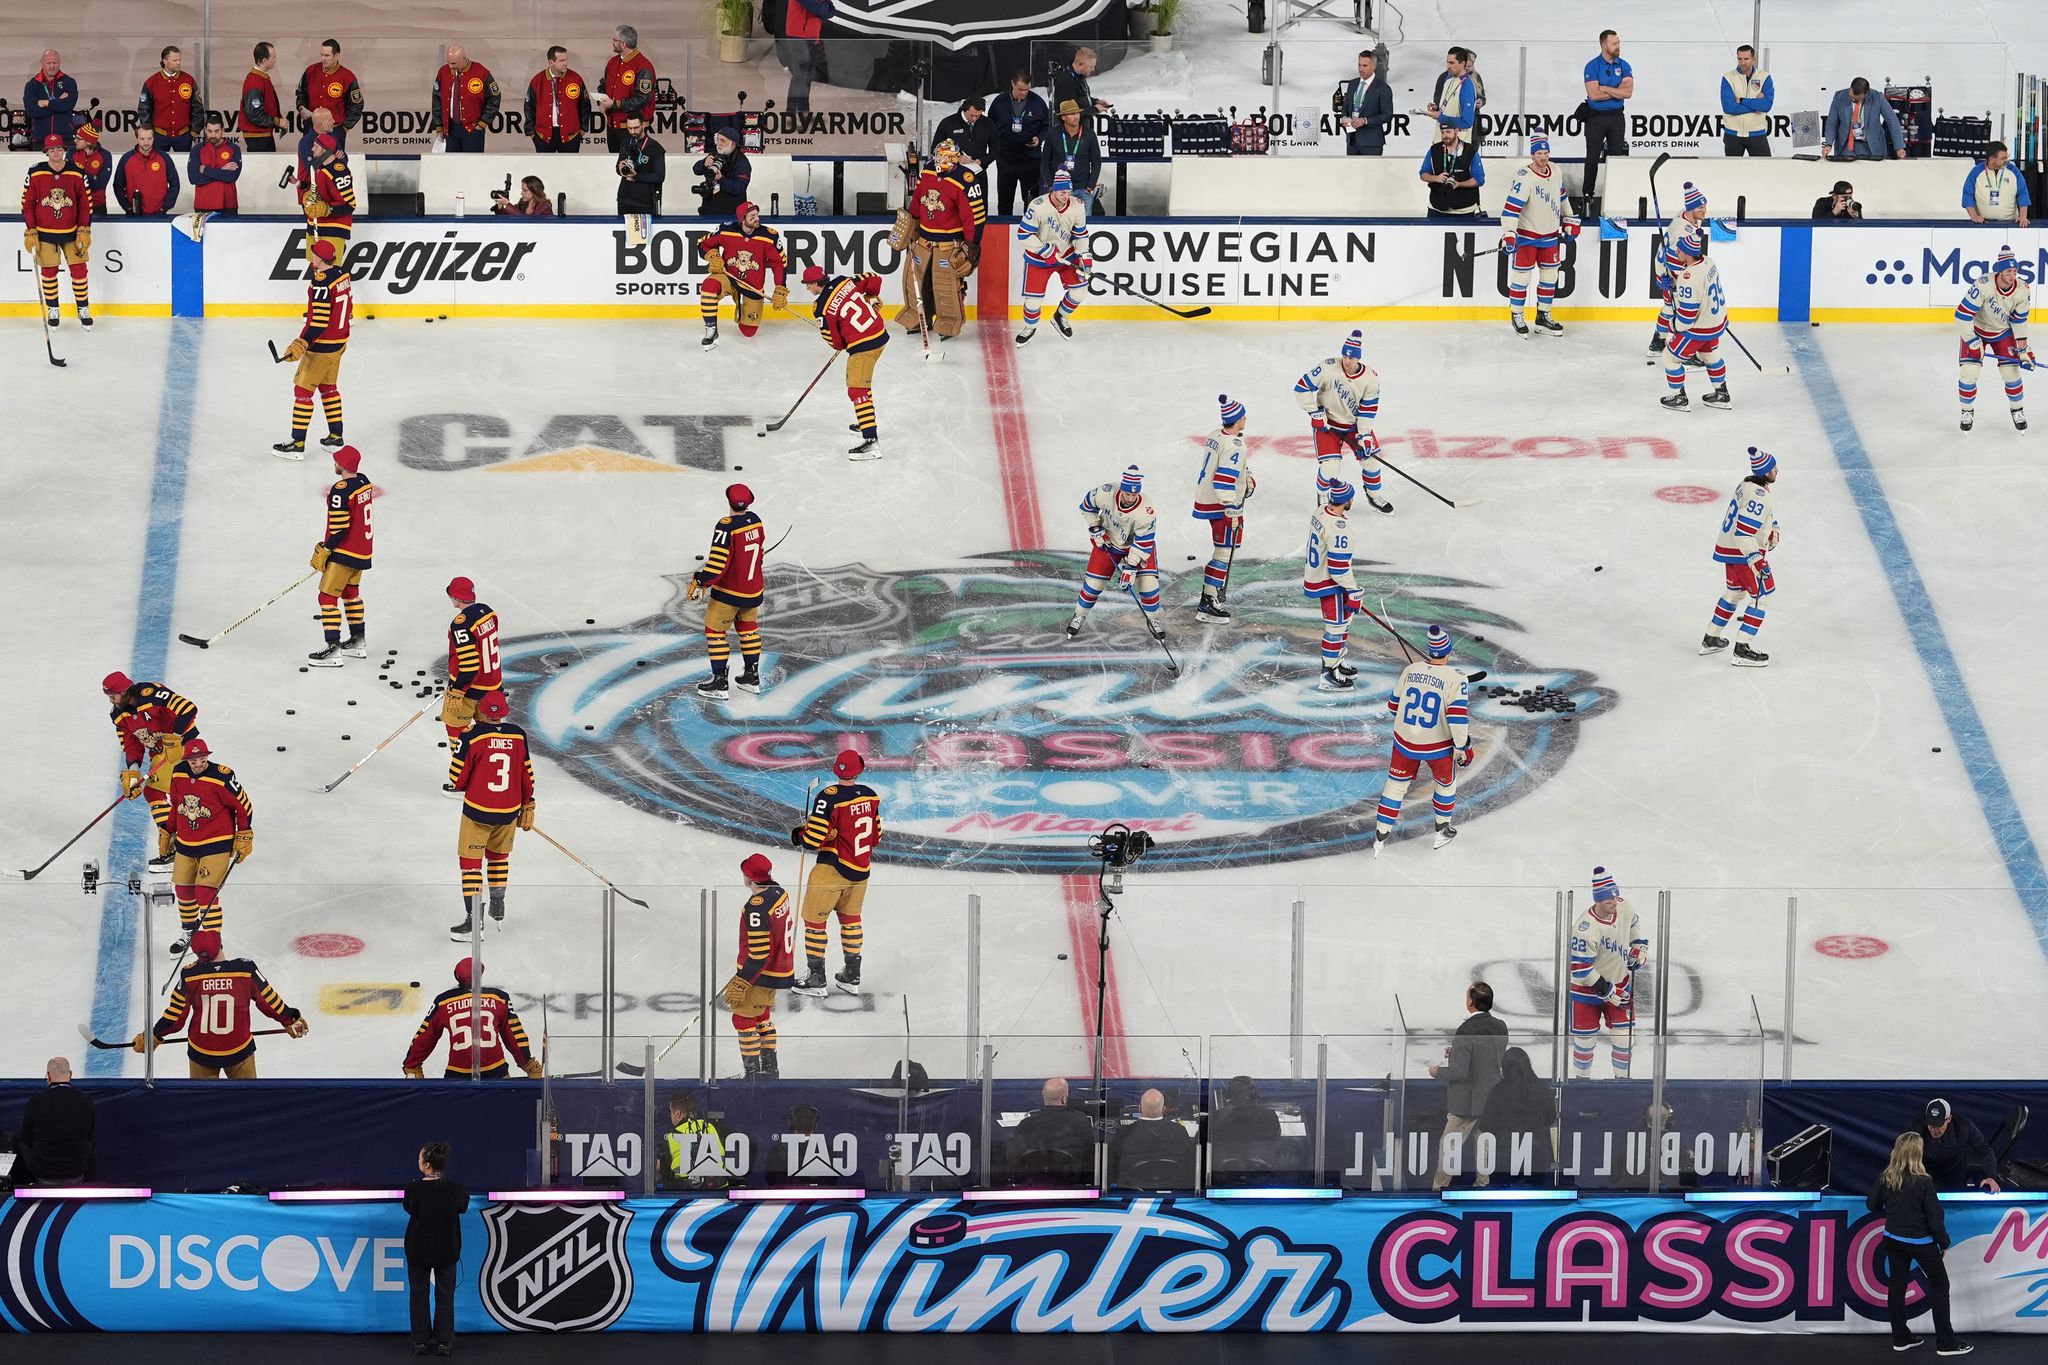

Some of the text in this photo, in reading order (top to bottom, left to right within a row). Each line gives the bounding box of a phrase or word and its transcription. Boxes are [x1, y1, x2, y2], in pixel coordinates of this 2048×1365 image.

[763, 111, 906, 135] ODYARMOR
[1476, 114, 1586, 137] DYARMO
[362, 137, 431, 145] SPORTS DRINK
[1631, 140, 1700, 148] SPORTS DRINK
[335, 175, 351, 190] 26
[967, 183, 982, 198] 40
[1060, 230, 1072, 242] YOR
[1088, 231, 1376, 264] ORWEGIAN
[268, 229, 537, 295] Eergizer
[312, 286, 329, 300] 77
[615, 282, 690, 296] SPORTS
[1087, 272, 1330, 297] CRUISE LINE
[1678, 286, 1692, 299] 39
[335, 293, 351, 330] 7
[839, 291, 878, 334] 27
[397, 412, 754, 472] CAT
[1230, 452, 1240, 465] 4
[331, 494, 342, 509] 9
[1746, 499, 1764, 517] 93
[1721, 498, 1739, 534] 3
[713, 529, 728, 545] 71
[1334, 534, 1348, 549] 16
[744, 542, 760, 581] 7
[453, 628, 470, 645] 15
[481, 630, 501, 674] 15
[1407, 672, 1445, 692] ROBERTSON
[1460, 681, 1468, 696] 2
[1403, 686, 1442, 730] 29
[488, 738, 513, 750] JONES
[487, 752, 511, 793] 3
[815, 799, 828, 815] 2
[944, 811, 1201, 837] Miami
[853, 815, 874, 857] 2
[749, 911, 762, 928] 6
[1571, 936, 1587, 953] 22
[202, 978, 233, 991] GREER
[200, 993, 235, 1035] 10
[446, 998, 497, 1014] STUDCKA
[449, 1010, 497, 1052] 53
[109, 1234, 406, 1292] DISCOVE
[514, 1227, 604, 1309] NHL
[664, 1198, 1342, 1333] Winter
[1380, 1217, 1927, 1310] CLASSIC
